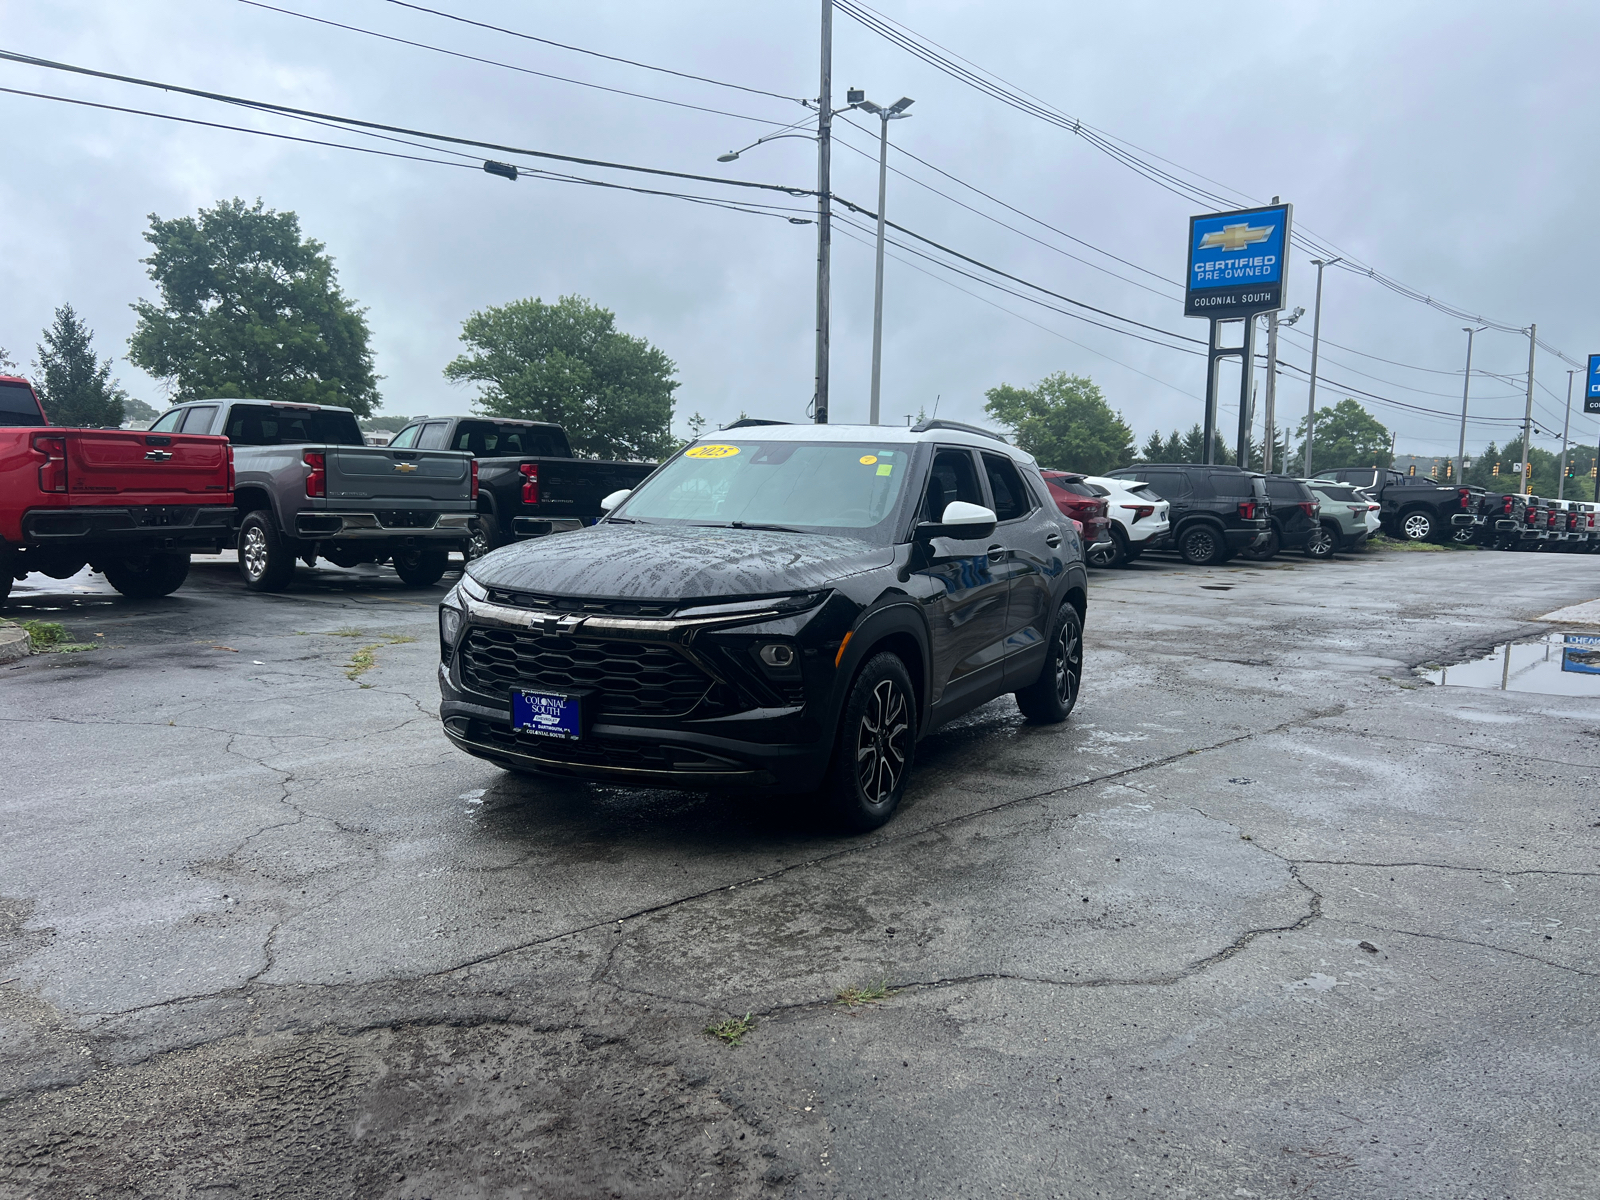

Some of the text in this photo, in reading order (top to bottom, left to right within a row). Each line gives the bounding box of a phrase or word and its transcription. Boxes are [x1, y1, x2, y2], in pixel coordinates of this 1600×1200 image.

[1194, 255, 1276, 272] CERTIFIED
[1197, 266, 1271, 281] PRE-OWNED
[1194, 293, 1271, 307] COLONIAL SOUTH
[690, 447, 735, 456] 2025
[525, 695, 567, 709] COLONIAL
[531, 704, 560, 716] SOUTH
[526, 728, 566, 739] COLONIAL SOUTH
